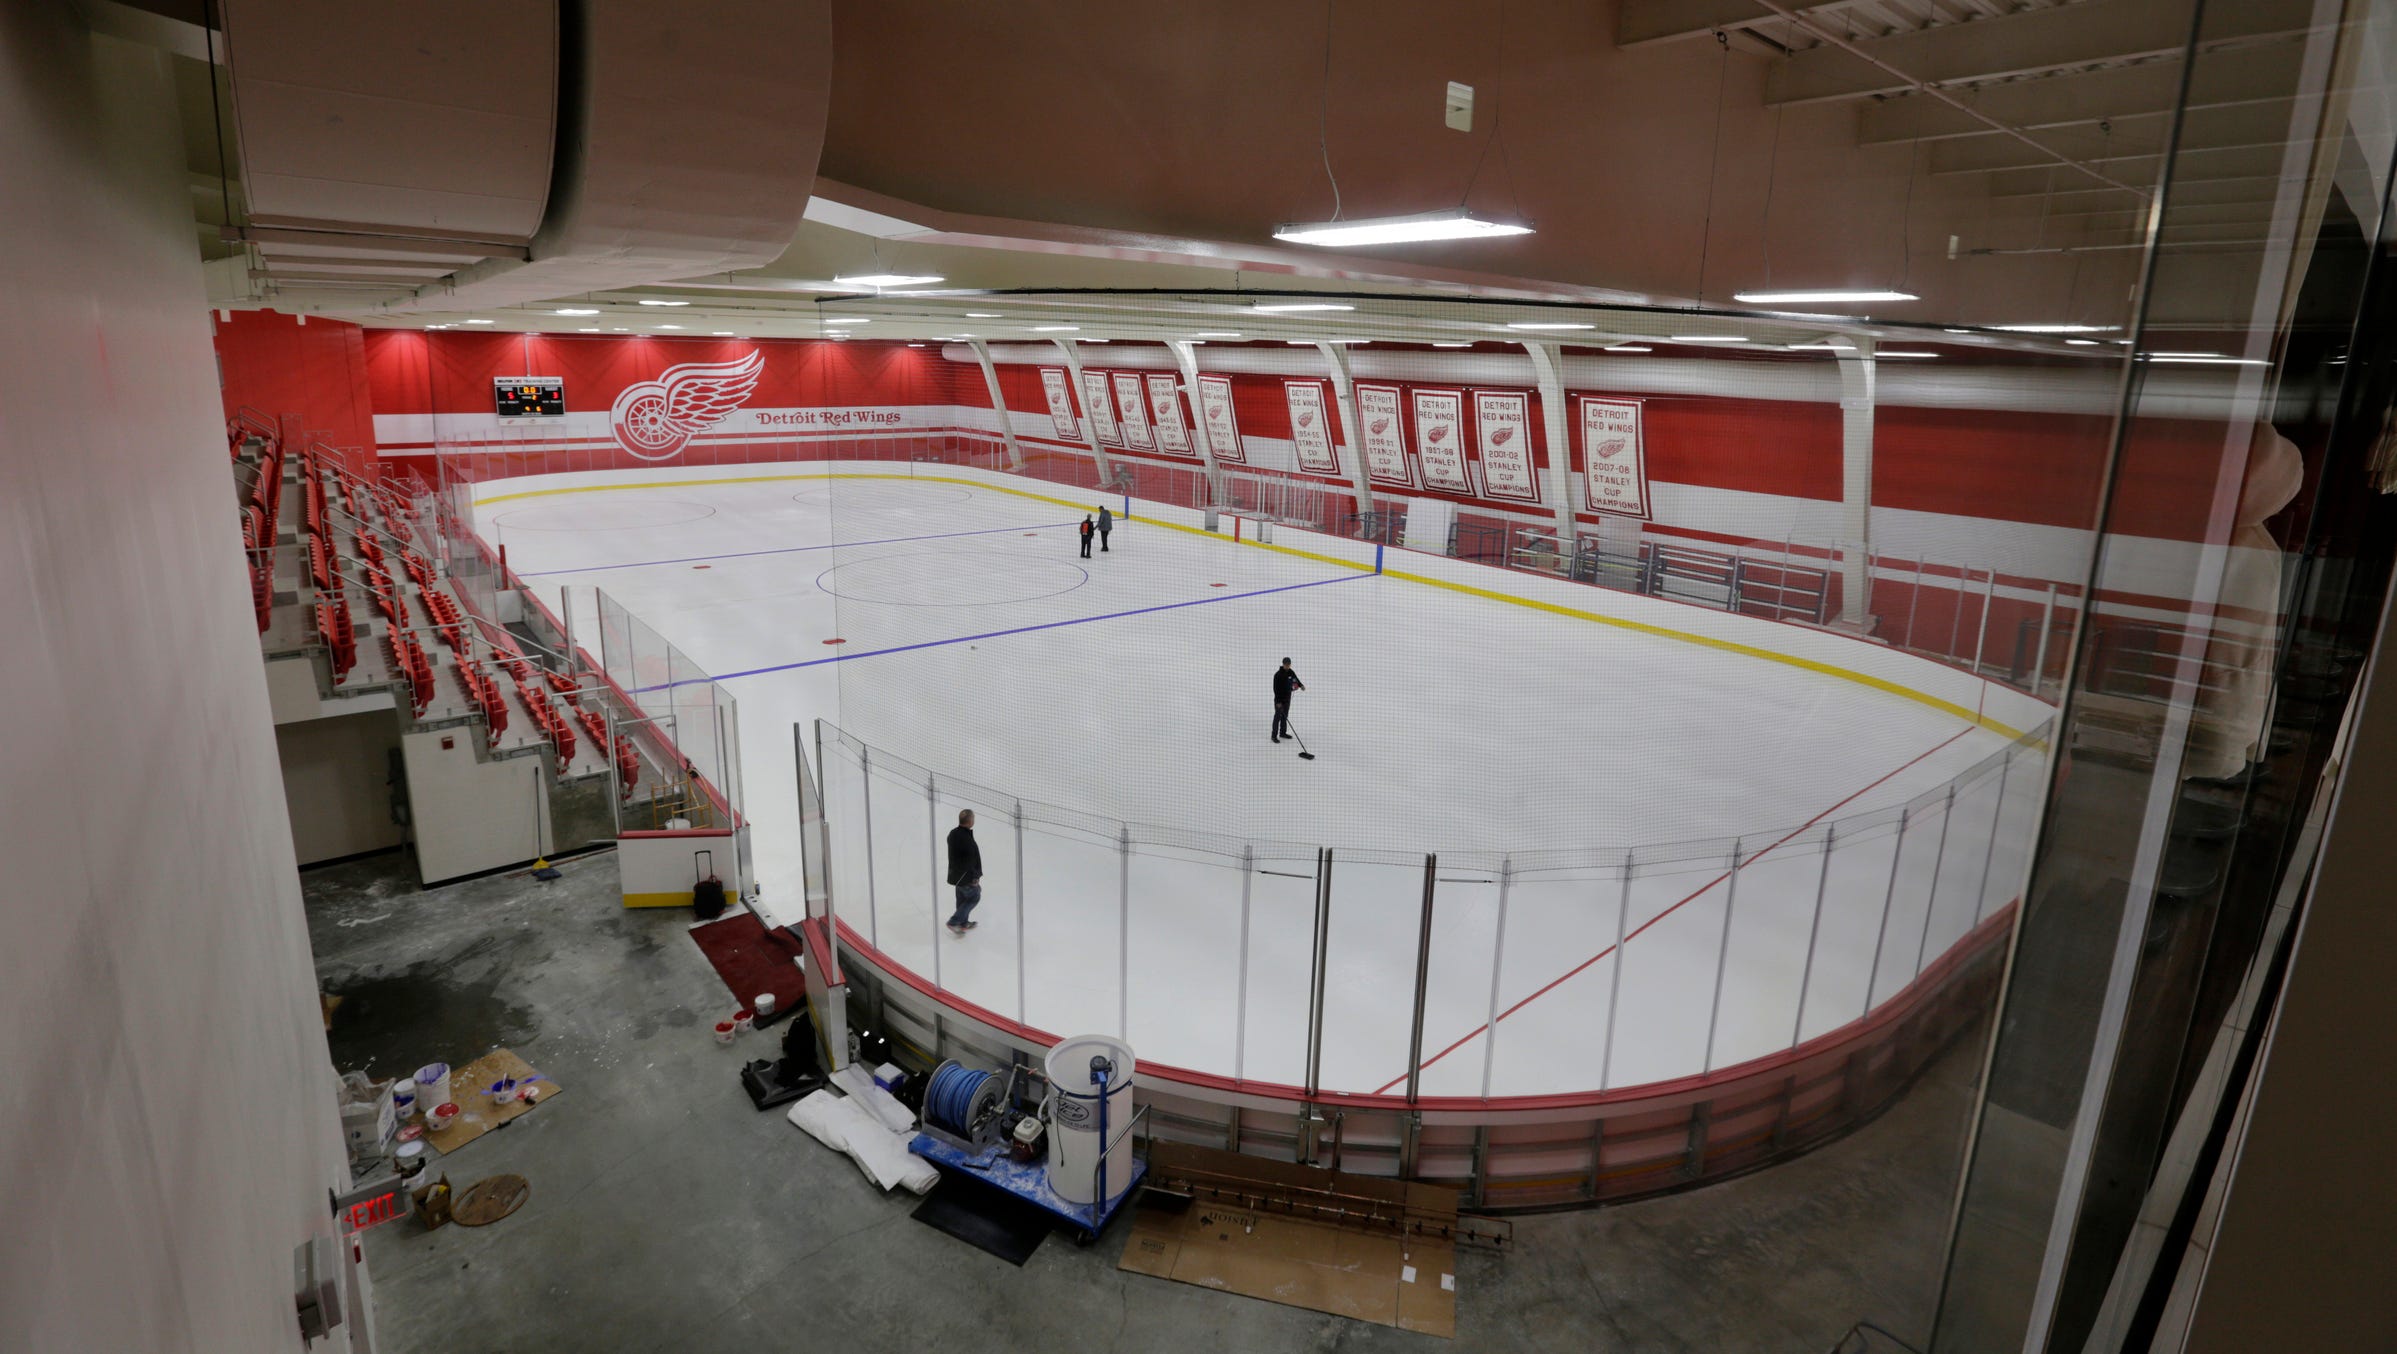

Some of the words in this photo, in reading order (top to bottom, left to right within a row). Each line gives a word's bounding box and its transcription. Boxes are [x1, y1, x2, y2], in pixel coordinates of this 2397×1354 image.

[1365, 394, 1392, 403] DETROIT
[1422, 400, 1451, 409] DETROIT
[1484, 401, 1517, 410] DETROIT
[1378, 406, 1396, 414] WINGS
[1592, 408, 1629, 420] DETROIT
[755, 411, 816, 425] Detroit
[819, 411, 851, 426] Red
[853, 410, 901, 426] Wings
[1419, 411, 1433, 419] RED
[1434, 413, 1455, 421] WINGS
[1482, 412, 1497, 421] RED
[1499, 413, 1521, 422] WINGS
[1587, 420, 1605, 430] RED
[1608, 423, 1634, 433] WINGS
[1369, 447, 1397, 456] STANLEY
[1488, 450, 1519, 460] 2001-02
[1425, 457, 1456, 466] STANLEY
[1488, 462, 1522, 471] STANLEY
[1436, 468, 1450, 476] CUP
[1593, 462, 1630, 474] 2007-08
[1427, 476, 1465, 488] CHAMPIONS
[1593, 475, 1631, 486] STANLEY
[1489, 482, 1530, 493] CHAMPIONS
[1604, 487, 1621, 496] CUP
[1592, 496, 1640, 510] CHAMPIONS
[351, 1191, 395, 1229] EXIT
